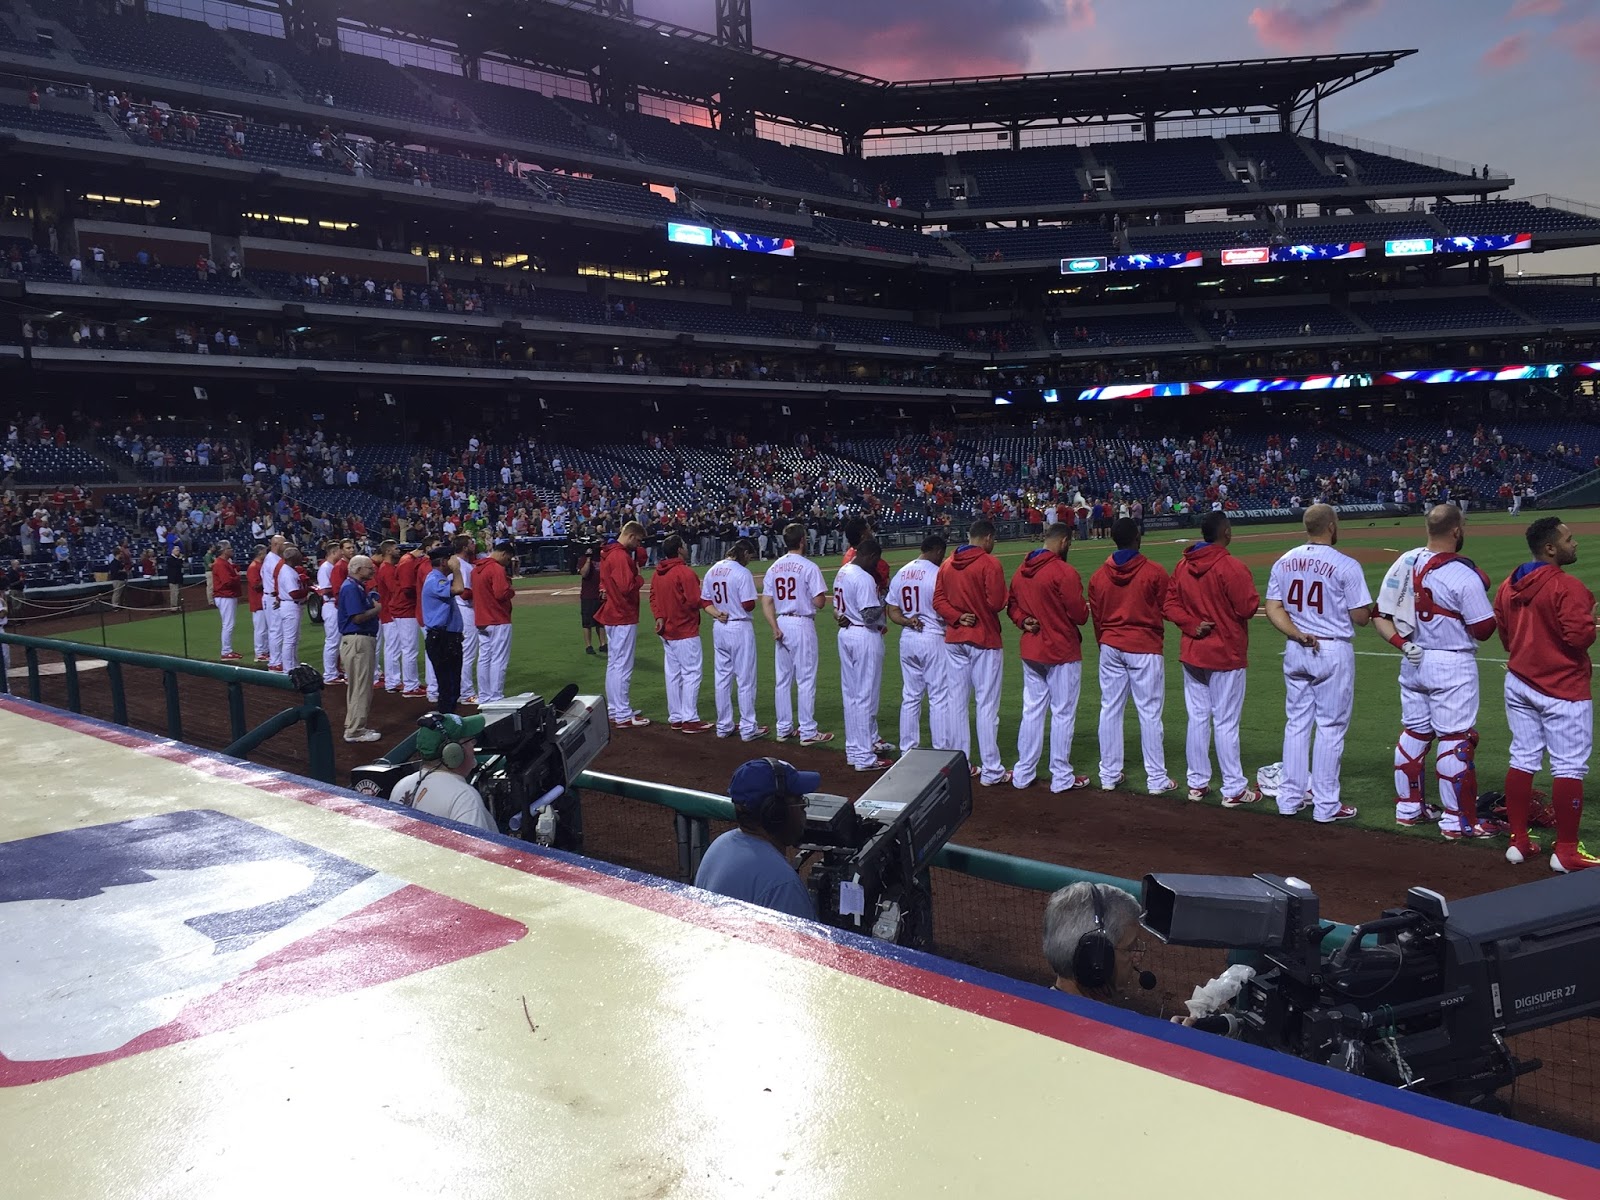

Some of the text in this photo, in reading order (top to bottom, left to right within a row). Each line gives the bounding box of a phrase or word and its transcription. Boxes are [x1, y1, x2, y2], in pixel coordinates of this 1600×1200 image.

[1223, 508, 1293, 518] MLB NETWORK
[1340, 504, 1386, 512] NETWORK
[901, 569, 926, 581] RAMOS
[1281, 558, 1337, 578] THOMPSON
[713, 581, 728, 604] 31
[775, 577, 796, 601] 62
[901, 586, 920, 612] 61
[1287, 579, 1323, 614] 44
[1440, 996, 1465, 1007] SONY
[1515, 989, 1564, 1009] DIGISUPER
[1565, 985, 1576, 997] 27
